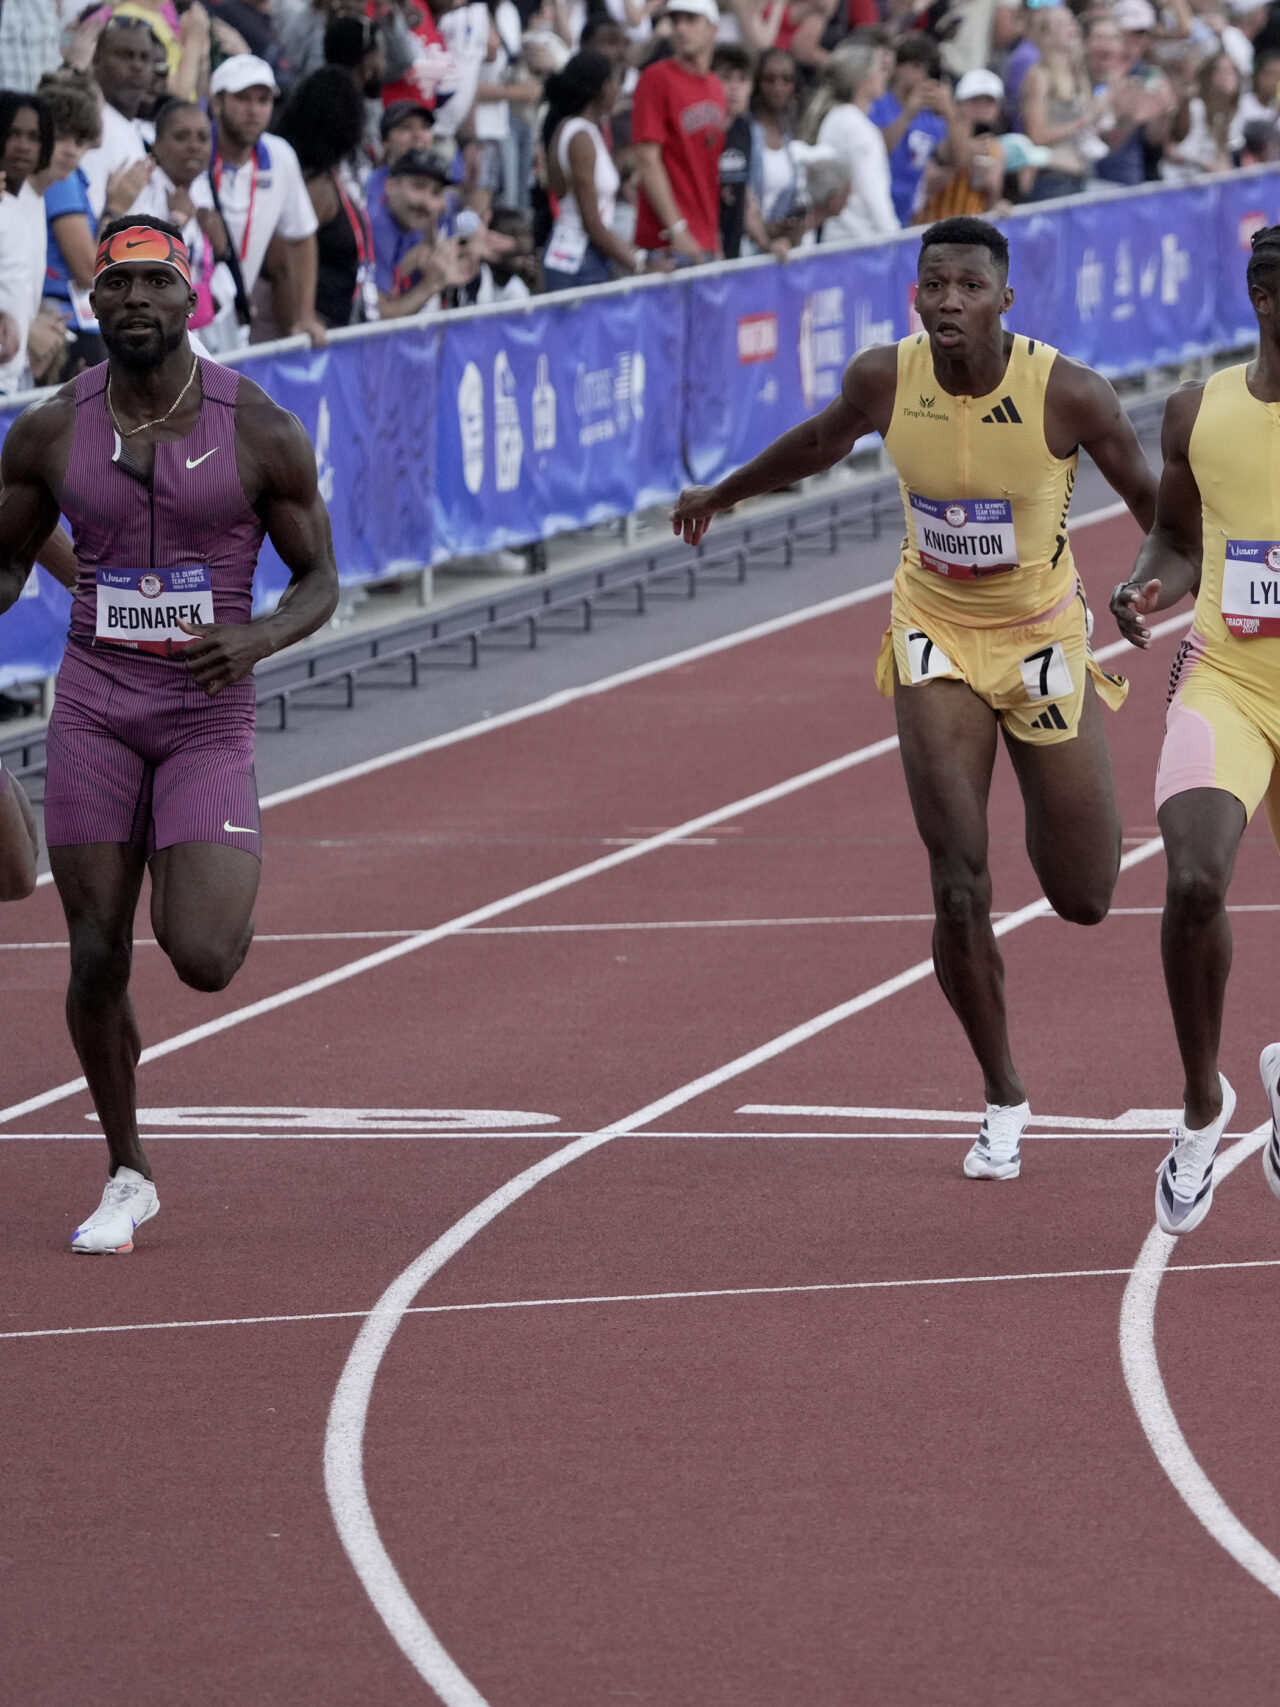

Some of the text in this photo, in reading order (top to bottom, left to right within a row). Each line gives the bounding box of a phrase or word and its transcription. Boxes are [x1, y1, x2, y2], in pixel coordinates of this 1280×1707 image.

[926, 411, 949, 421] Angels
[924, 527, 1003, 555] KNIGHTON
[108, 604, 203, 629] BEDNAREK
[1225, 617, 1260, 626] TRACKTOWN
[1242, 625, 1258, 633] 2024
[909, 633, 933, 675] 7
[1024, 647, 1054, 696] 7
[85, 1106, 560, 1129] 8
